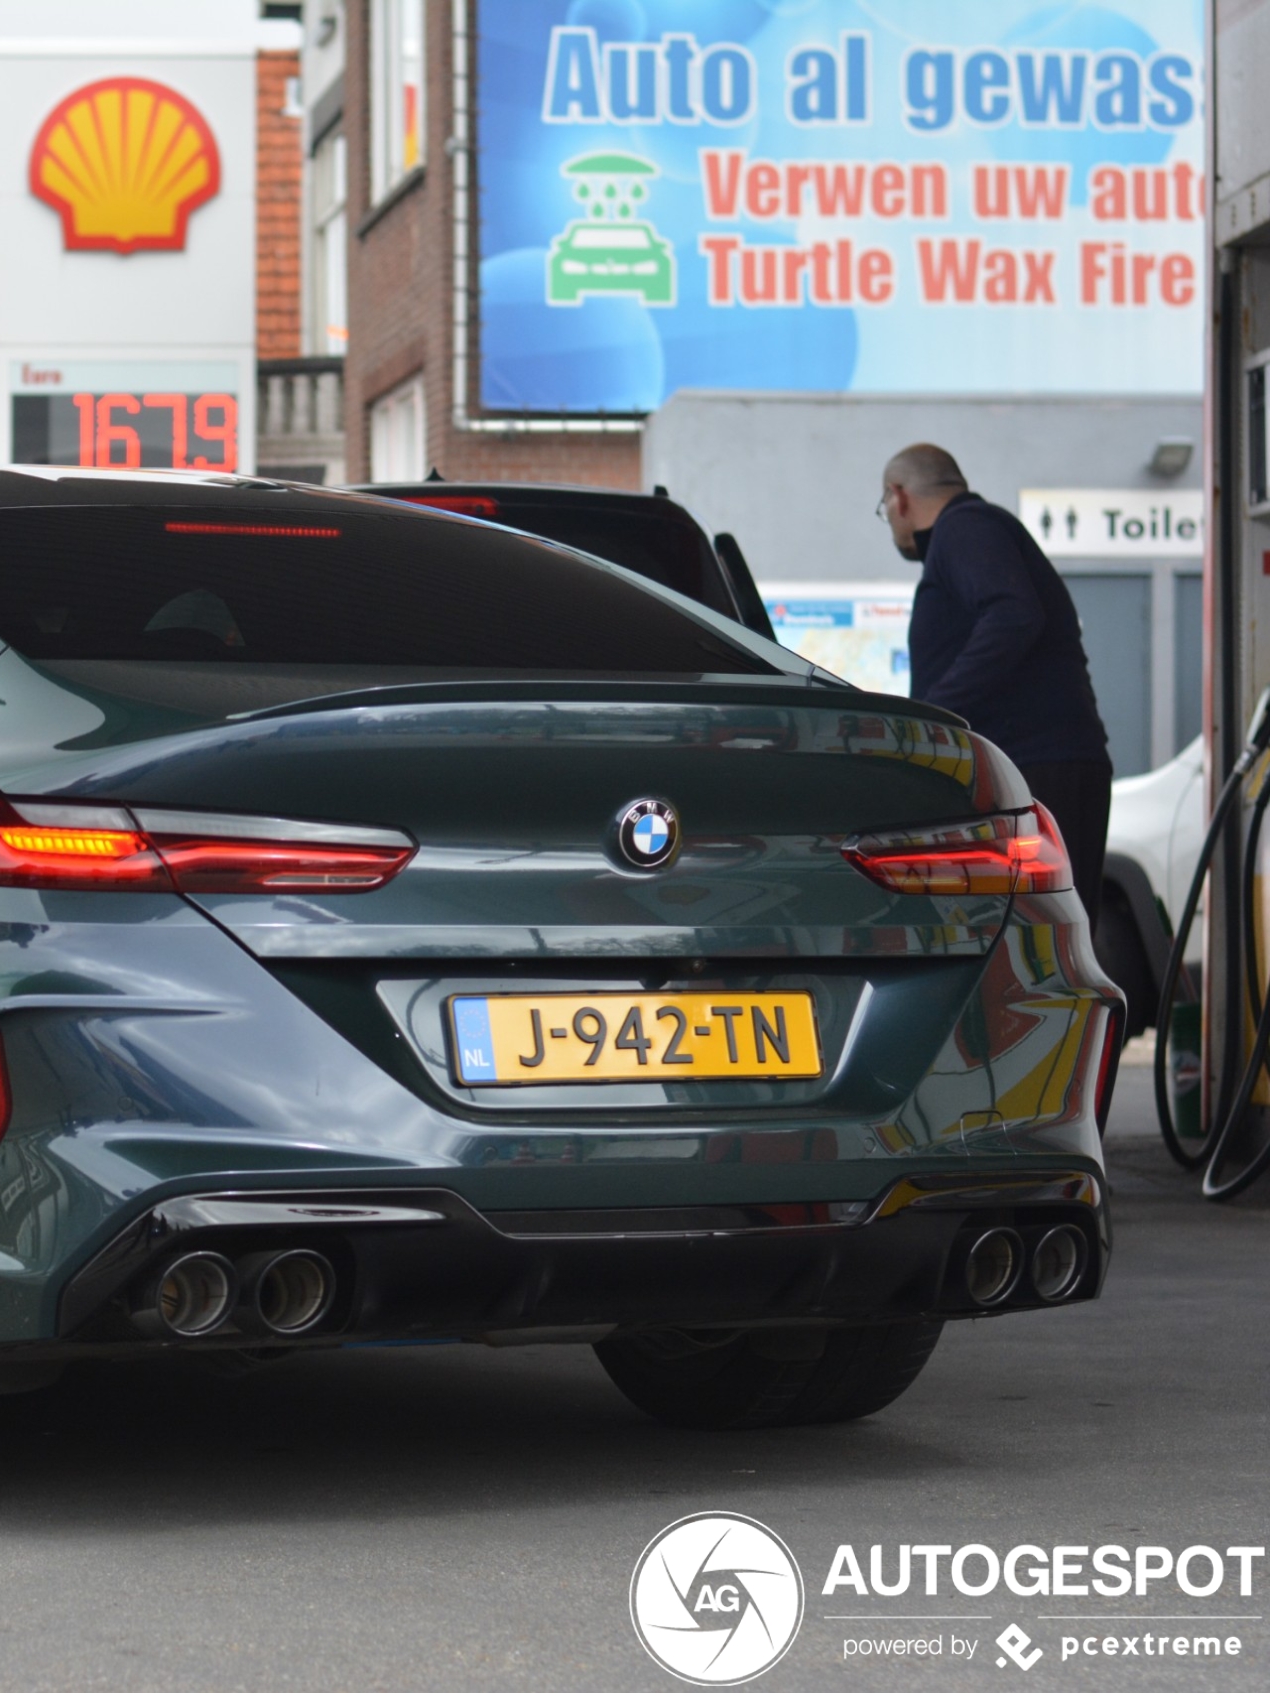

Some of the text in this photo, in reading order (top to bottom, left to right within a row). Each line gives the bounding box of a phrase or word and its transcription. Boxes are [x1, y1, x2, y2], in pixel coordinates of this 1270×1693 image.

[547, 31, 1205, 131] Auto al gewas
[702, 152, 1206, 222] Verwen uw aut
[701, 237, 1196, 307] Turtle Wax Fire
[1103, 506, 1205, 541] Toile
[627, 802, 675, 824] BMW
[464, 1048, 490, 1068] NL
[518, 1005, 791, 1067] J-942-TN
